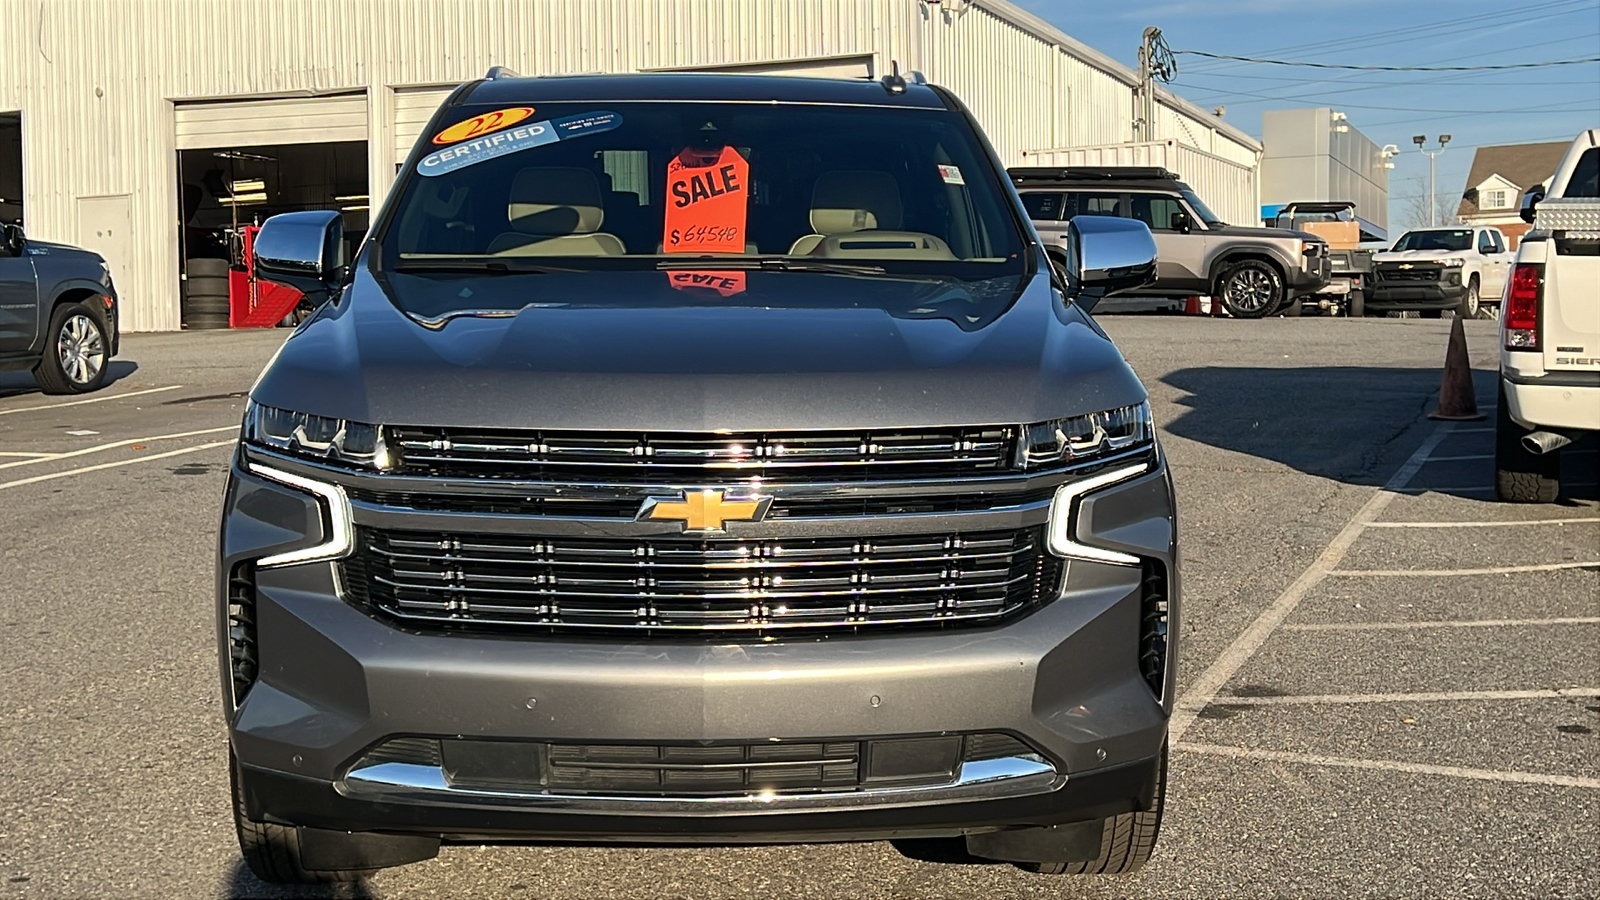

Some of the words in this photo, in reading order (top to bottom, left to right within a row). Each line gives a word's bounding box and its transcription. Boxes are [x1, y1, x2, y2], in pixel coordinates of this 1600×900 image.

[464, 112, 504, 137] 22
[423, 125, 546, 167] CERTIFIED
[672, 164, 740, 208] SALE
